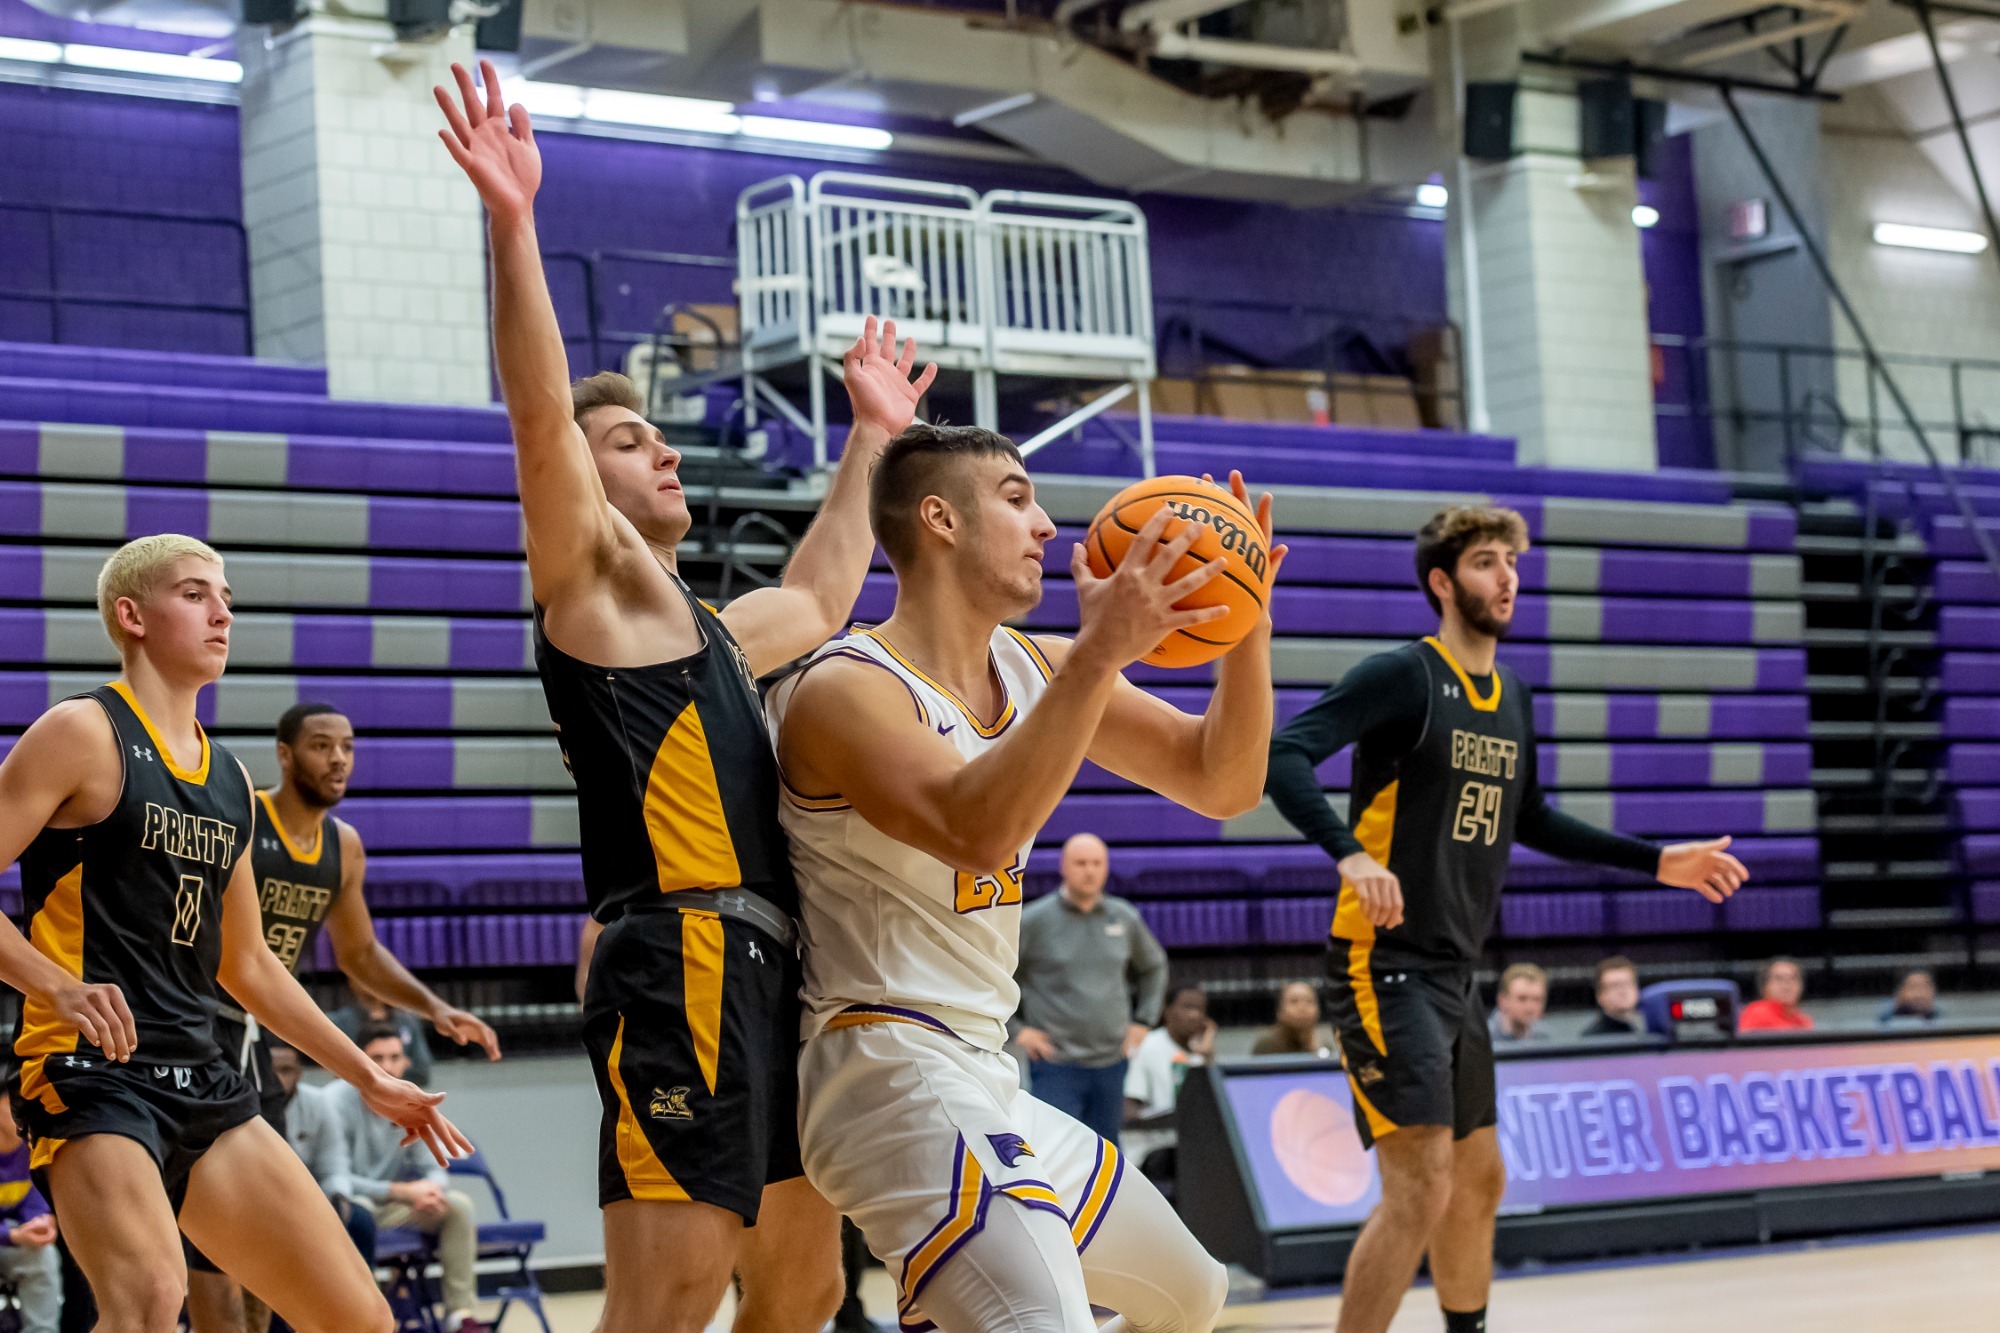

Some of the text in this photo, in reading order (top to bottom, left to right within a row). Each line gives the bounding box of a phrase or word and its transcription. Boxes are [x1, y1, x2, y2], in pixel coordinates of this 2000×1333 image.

[1164, 500, 1266, 584] Wilson
[1452, 729, 1518, 780] PRATT
[141, 802, 236, 869] PRATT
[1453, 781, 1502, 846] 24
[171, 874, 203, 947] 0
[260, 877, 332, 922] PRATT
[1500, 1058, 2000, 1181] NTER BASKETBAL
